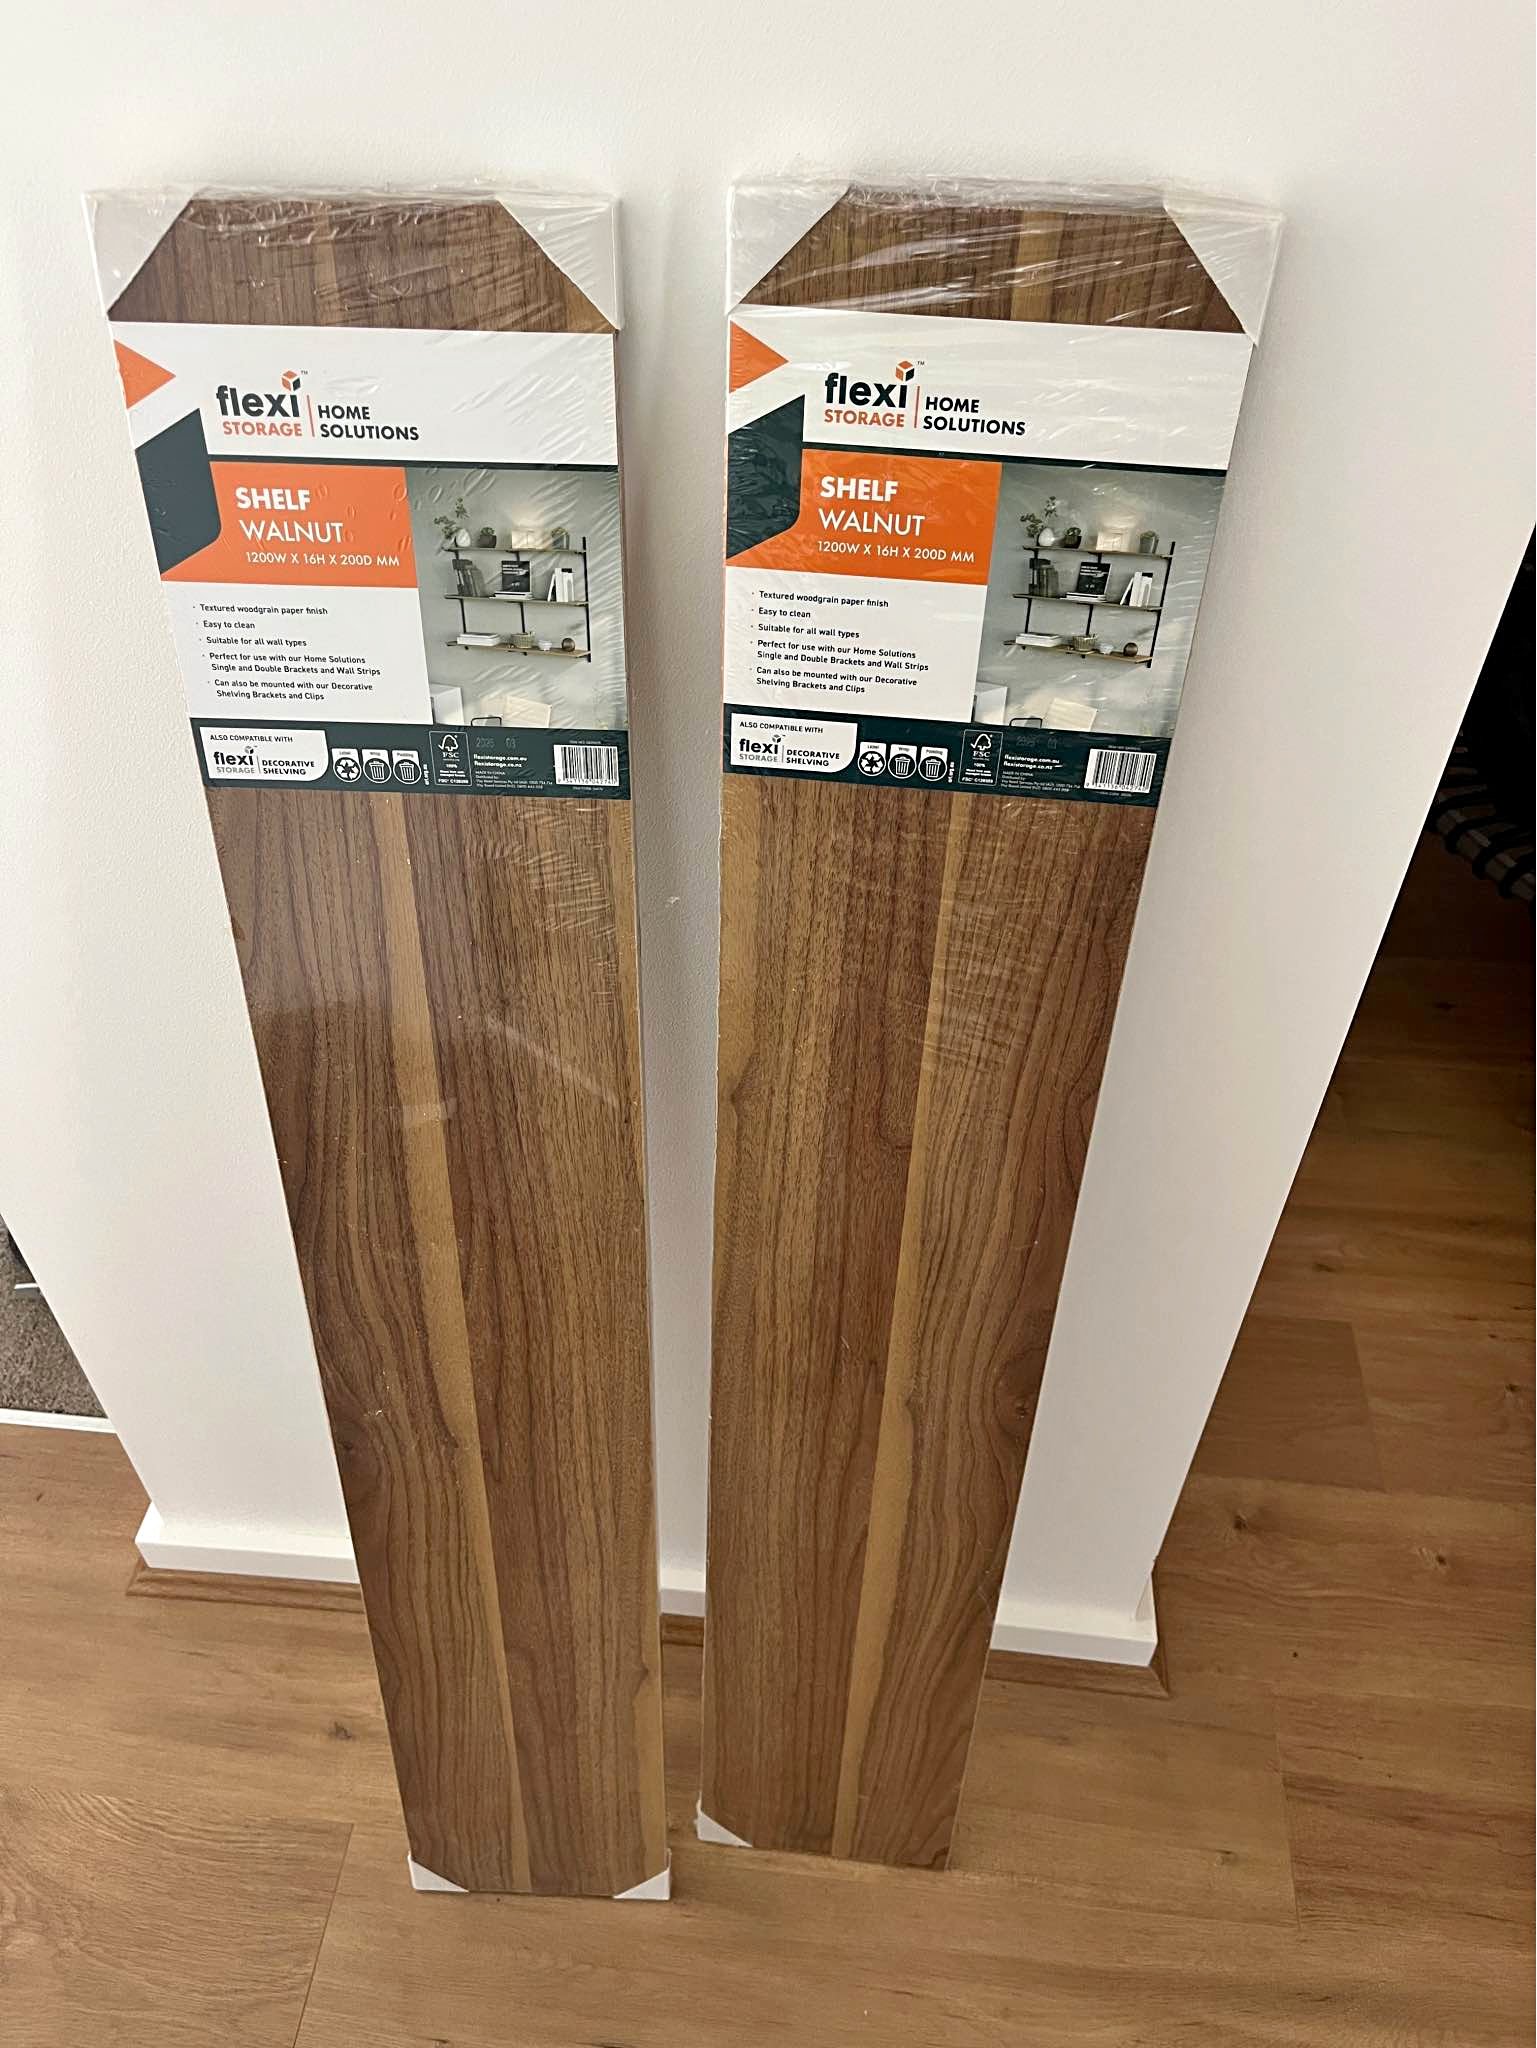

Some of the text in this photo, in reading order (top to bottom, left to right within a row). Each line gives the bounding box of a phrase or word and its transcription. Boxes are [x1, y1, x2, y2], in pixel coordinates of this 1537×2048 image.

[824, 372, 908, 409] flexi
[216, 384, 301, 418] flexi
[925, 396, 980, 414] HOME
[317, 404, 371, 420] HOME
[824, 409, 905, 428] STORAGE
[222, 420, 303, 437] STORAGE
[319, 423, 420, 441] SOLUTIONS
[922, 415, 1026, 436] SOLUTIONS
[819, 475, 899, 502] SHELF
[235, 486, 311, 511] SHELF
[818, 508, 926, 537] WALNUT
[238, 519, 344, 543] WALNUT
[245, 551, 400, 567] 1200W X 16H X 200D MM
[818, 540, 974, 563] 1200W X 16H X 200D MM
[759, 590, 889, 608] Textured woodgrain paper finish
[199, 603, 328, 616] Textured woodgrain paper finish
[758, 606, 811, 618] Easy to clean
[202, 619, 256, 630] Easy to clean
[758, 623, 860, 639] Suitable for all wall types
[206, 636, 307, 648] Suitable for all wall types
[757, 639, 786, 649] Perfect
[788, 641, 800, 650] for
[817, 644, 836, 653] with
[853, 646, 877, 656] Home
[878, 648, 916, 659] Solutions
[209, 652, 238, 661] Perfect
[239, 653, 251, 661] for
[268, 654, 287, 662] with
[303, 655, 327, 663] Home
[328, 655, 366, 664] Solutions
[757, 650, 929, 672] Single and Double Brackets and Wall Strips
[211, 663, 236, 673] Single
[238, 664, 253, 672] and
[254, 664, 282, 673] Double
[283, 665, 319, 674] Brackets
[336, 666, 355, 675] Wall
[356, 667, 381, 677] Strips
[756, 666, 772, 674] Can
[773, 668, 790, 676] also
[803, 671, 838, 680] mounted
[839, 674, 857, 682] with
[875, 675, 918, 686] Decorative
[214, 678, 230, 687] Can
[231, 679, 248, 687] also
[249, 680, 259, 688] be
[260, 681, 295, 689] mounted
[331, 682, 373, 691] Decorative
[756, 677, 865, 694] Shelving Brackets and Clips
[216, 689, 325, 701] Shelving Brackets and Clips
[739, 721, 824, 734] ALSO COMPATIBLE WITH
[229, 734, 272, 742] COMPATIBLE
[739, 737, 780, 755] flexi
[213, 751, 254, 767] flexi
[739, 753, 779, 763] STORAGE
[786, 748, 841, 761] DECORATIVE
[786, 755, 831, 768] SHELVING
[972, 750, 991, 758] FSC
[216, 766, 255, 775] STORAGE
[261, 759, 316, 769] DECORATIVE
[263, 767, 307, 776] SHELVING
